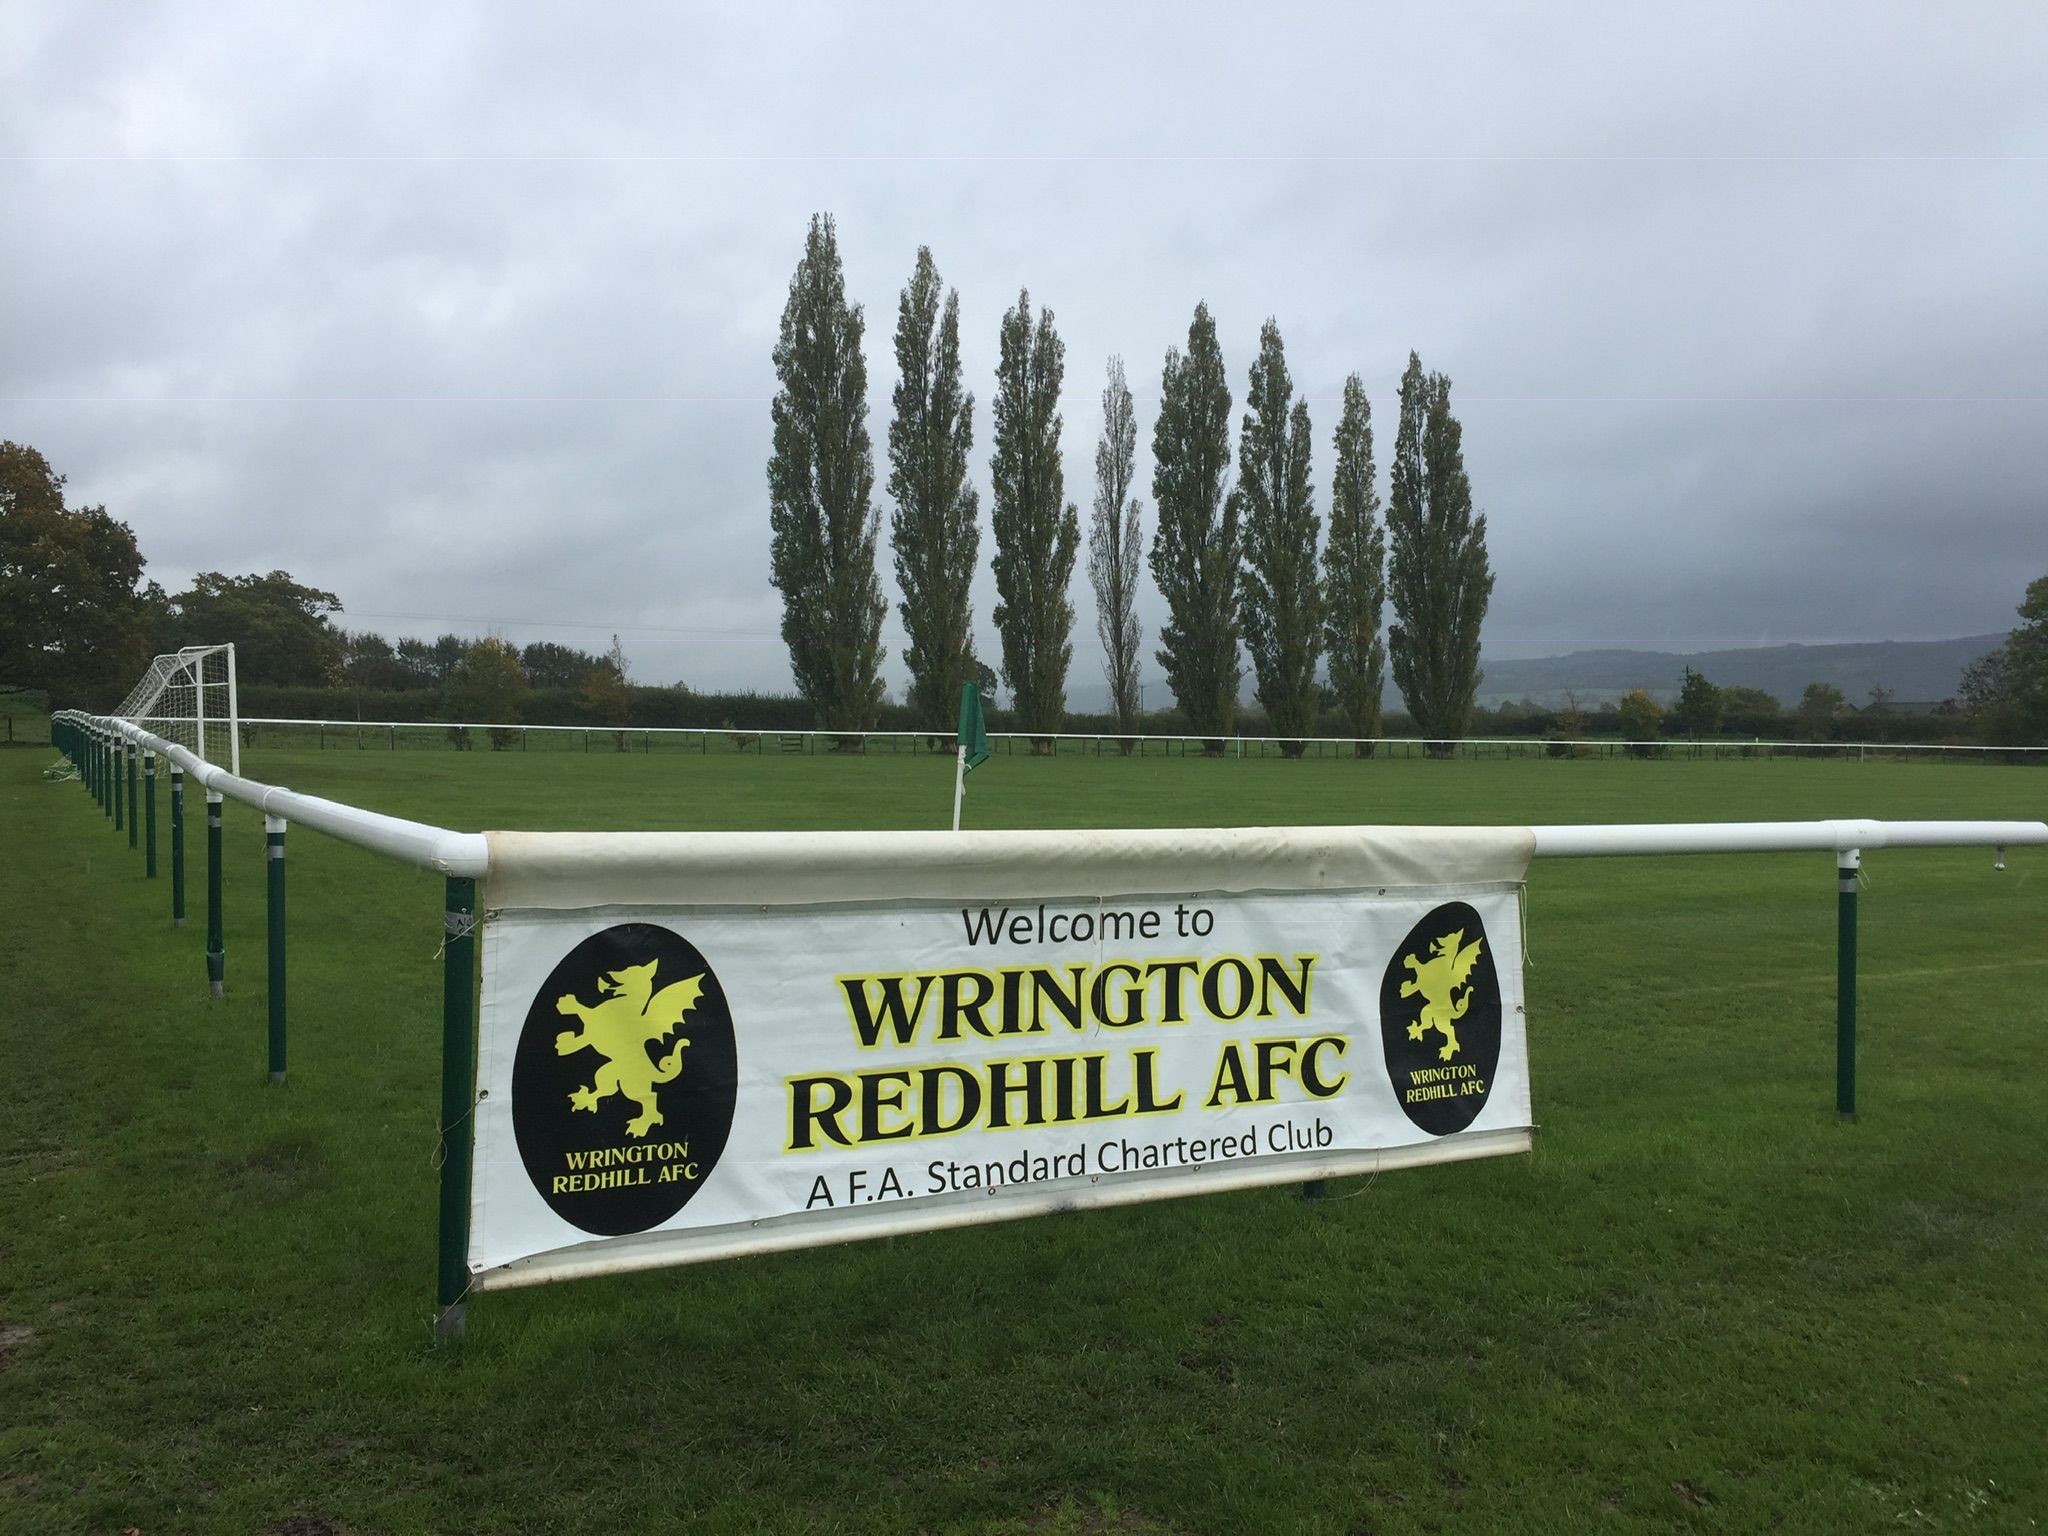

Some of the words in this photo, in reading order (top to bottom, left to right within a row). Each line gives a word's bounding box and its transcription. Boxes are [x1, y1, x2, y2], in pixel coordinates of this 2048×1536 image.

[961, 904, 1162, 947] Welcome
[1175, 904, 1215, 937] to
[839, 956, 1317, 1047] WRINGTON
[1406, 1083, 1458, 1103] REDHILL
[1460, 1079, 1485, 1096] AFC
[1409, 1063, 1477, 1085] WRINGTON
[787, 1050, 1183, 1150] REDHILL
[1205, 1037, 1347, 1107] AFC
[565, 1141, 689, 1171] WRINGTON
[806, 1175, 836, 1209] A
[848, 1166, 915, 1206] F.A.
[927, 1143, 1087, 1194] Standard
[1098, 1124, 1258, 1174] Chartered
[1267, 1118, 1334, 1153] Club
[552, 1167, 652, 1194] REDHILL
[657, 1162, 699, 1183] AFC
